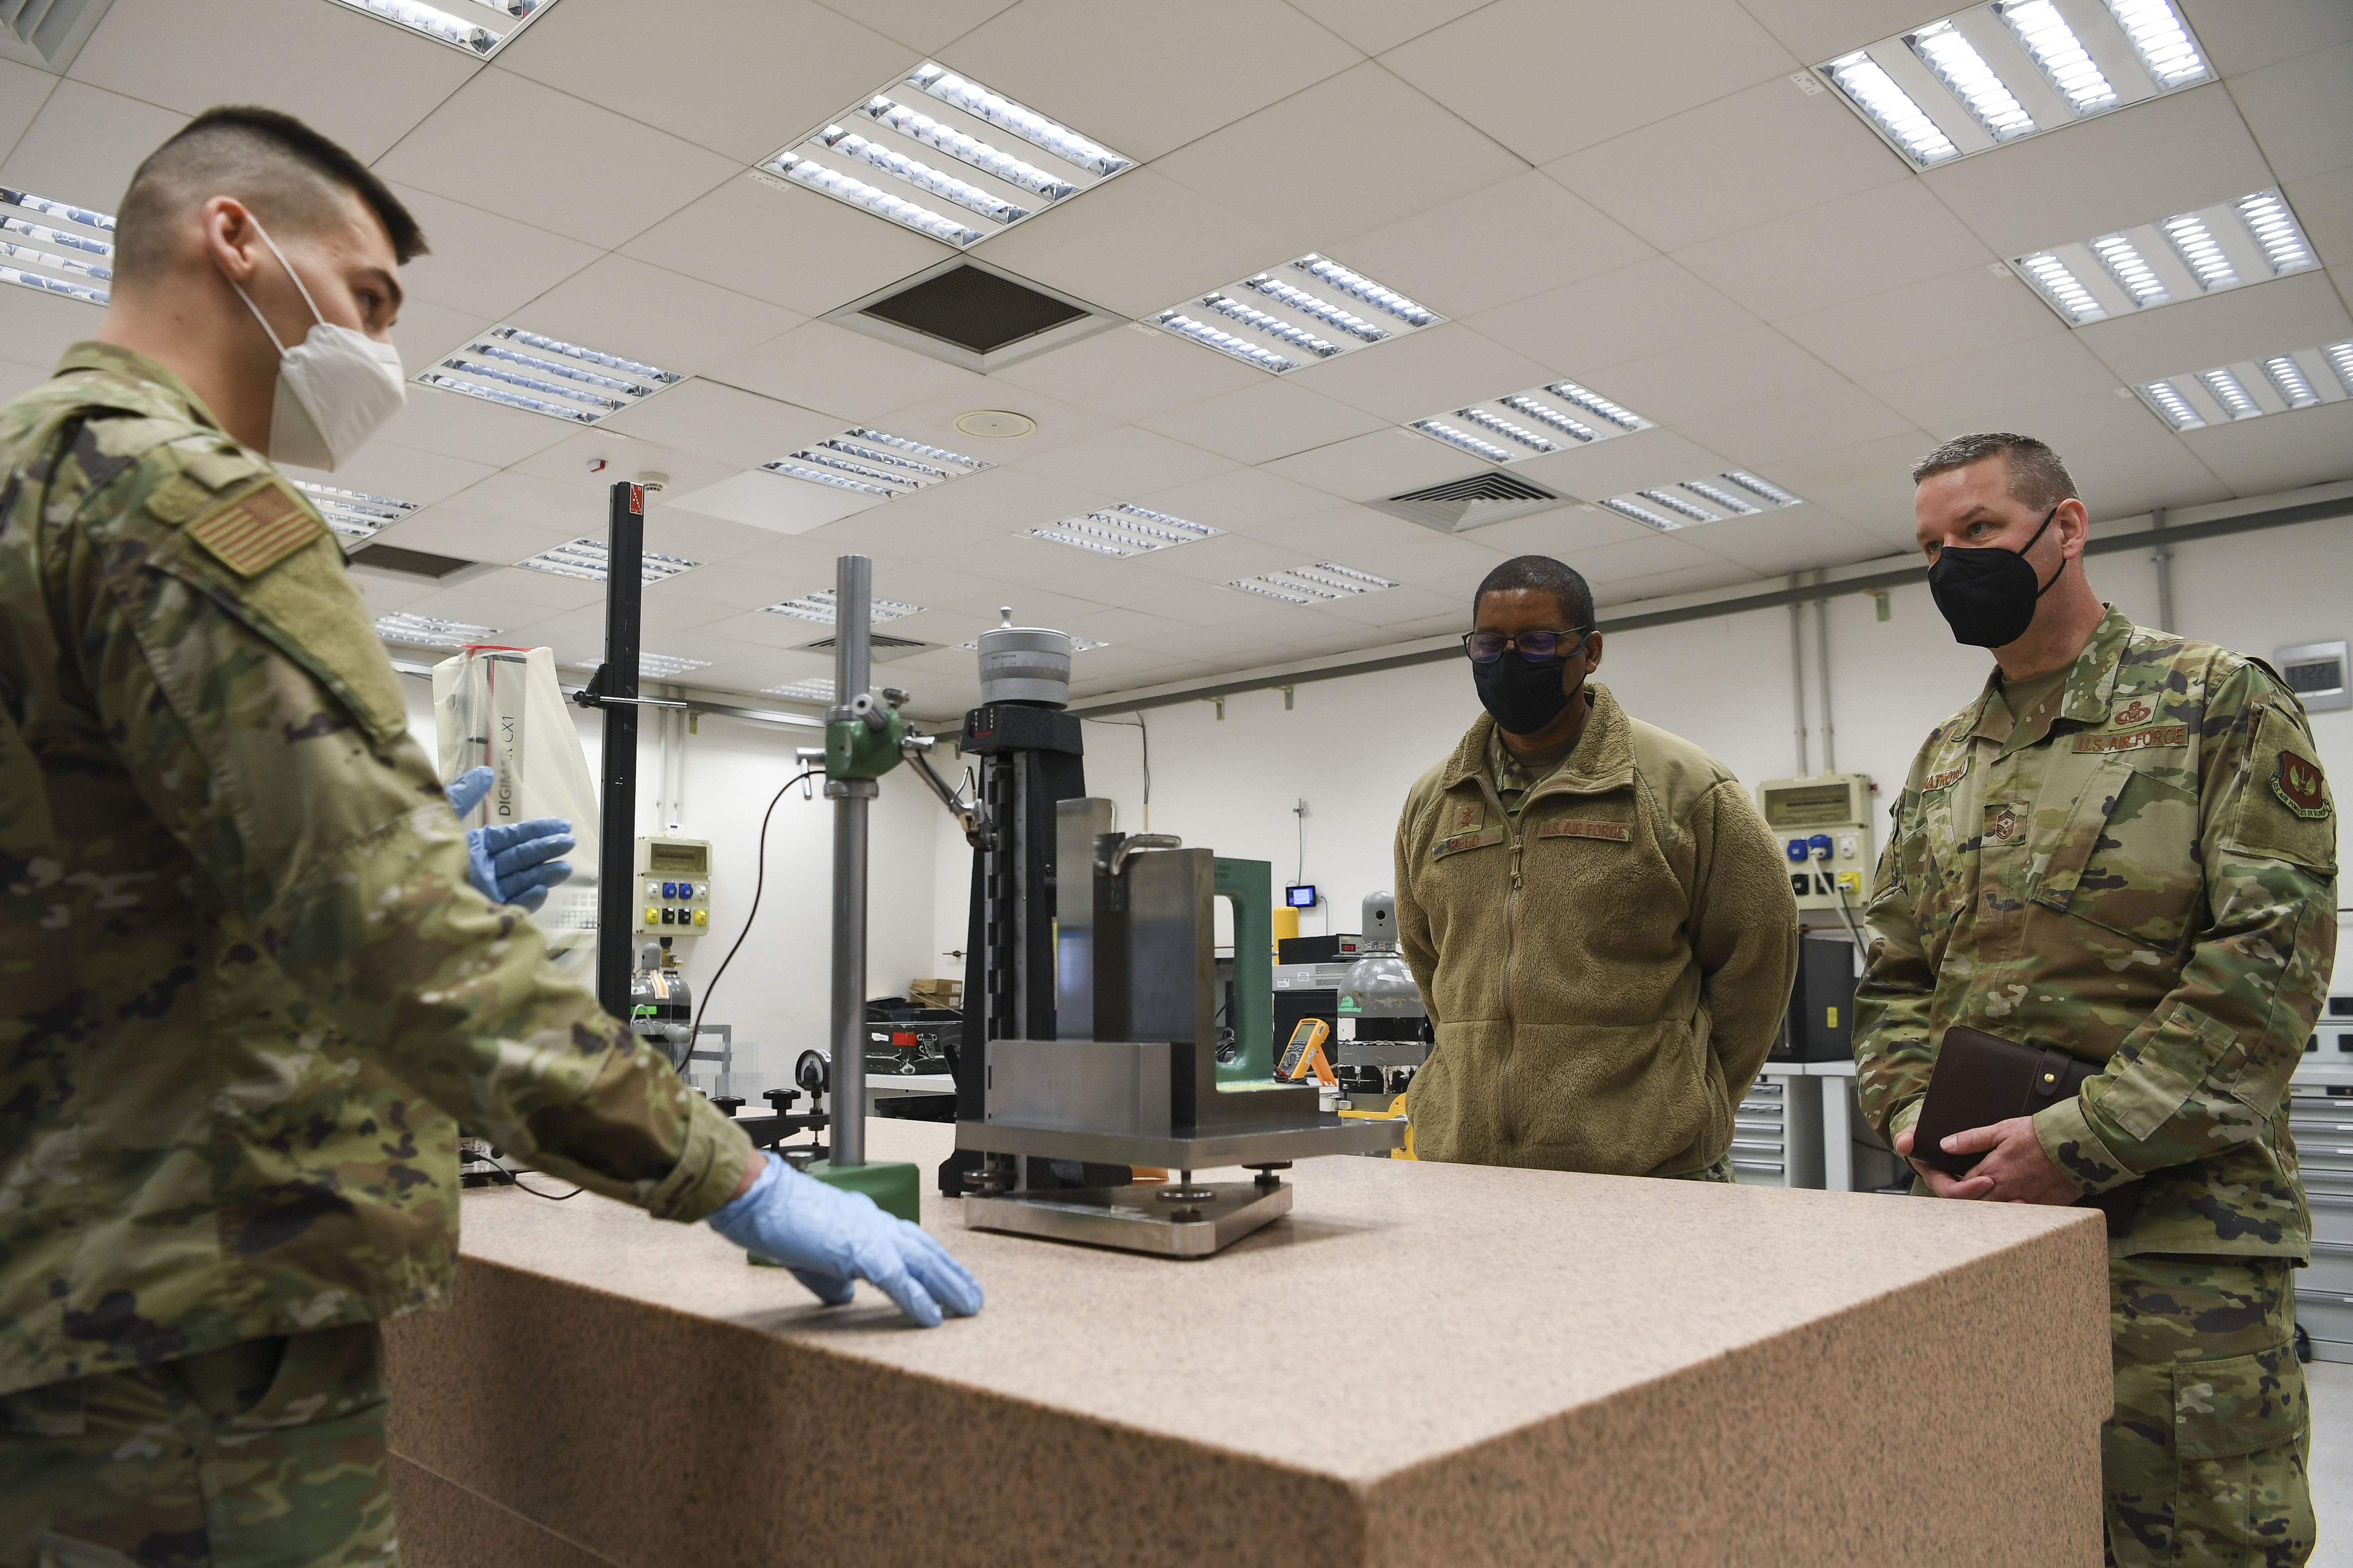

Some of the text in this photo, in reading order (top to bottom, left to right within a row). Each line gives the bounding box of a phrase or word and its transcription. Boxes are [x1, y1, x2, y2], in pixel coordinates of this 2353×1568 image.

[502, 716, 514, 743] CX1
[2079, 727, 2183, 752] U.S. AIR FORCE
[2278, 793, 2288, 802] AIR
[2288, 801, 2307, 816] FORCES
[1564, 822, 1582, 835] AIR
[1587, 822, 1625, 839] FORCE
[1450, 833, 1479, 852] REED
